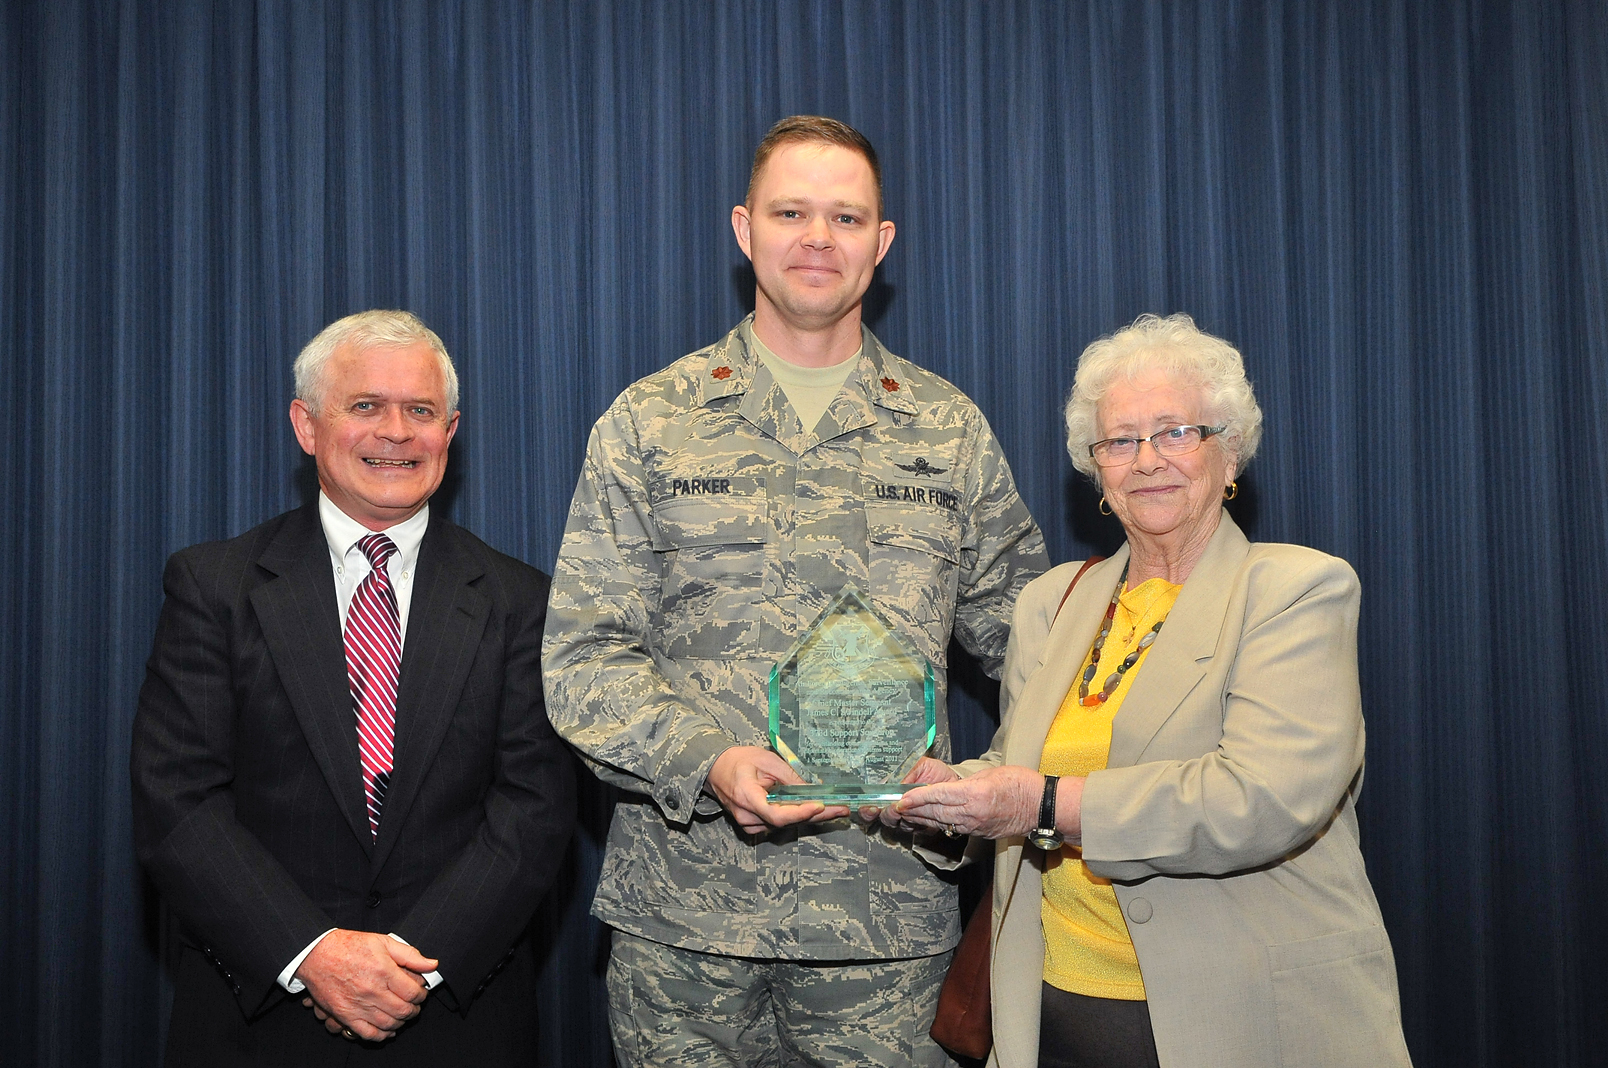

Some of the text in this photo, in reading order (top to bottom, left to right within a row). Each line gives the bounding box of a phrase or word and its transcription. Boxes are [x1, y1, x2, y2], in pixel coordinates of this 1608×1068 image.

[672, 479, 731, 496] PARKER
[875, 484, 959, 511] U.S. AIR FORCE
[861, 699, 891, 708] Seant
